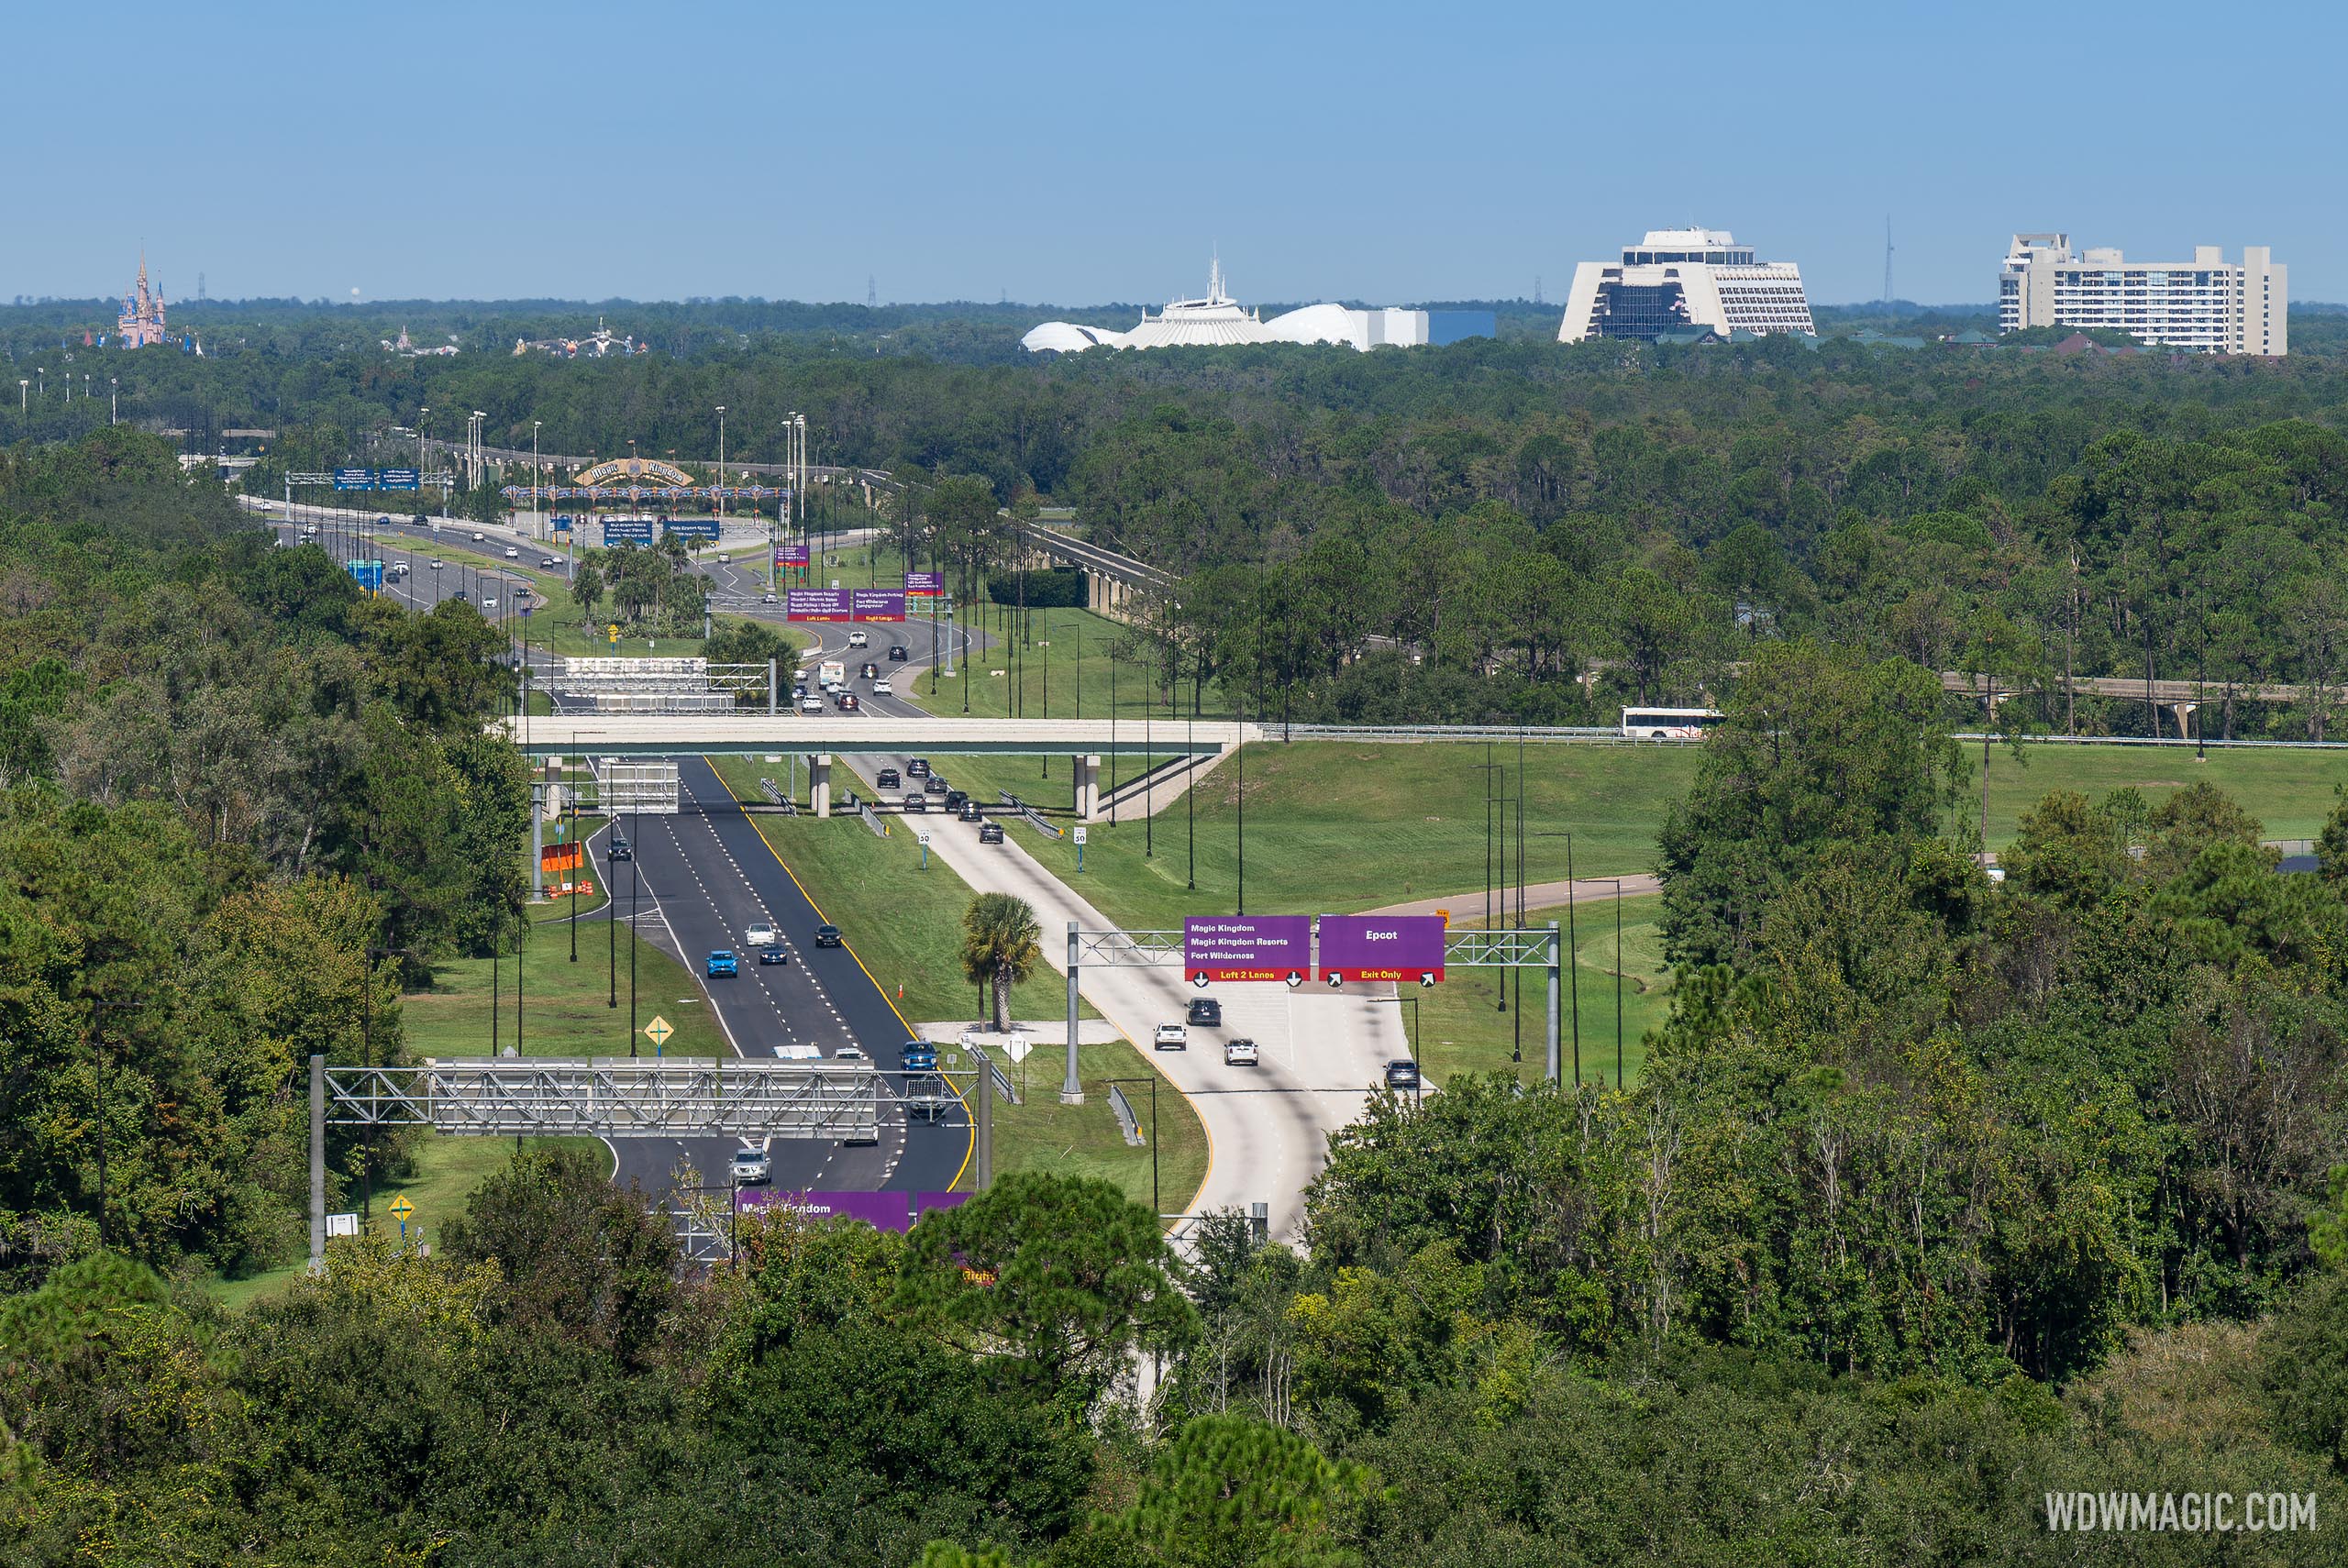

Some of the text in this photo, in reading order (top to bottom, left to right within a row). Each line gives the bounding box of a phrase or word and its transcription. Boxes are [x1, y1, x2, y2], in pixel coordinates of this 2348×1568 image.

[591, 462, 684, 482] Magic Kingdom
[1191, 924, 1256, 933] Magic Kingdom
[1366, 930, 1398, 941] Epcot
[1191, 938, 1289, 947] Magic Kingdom Resorts
[1191, 951, 1255, 960] Fort Wilderness
[1220, 970, 1275, 979] Left 2 Lanes
[1361, 970, 1401, 980] Exit Only
